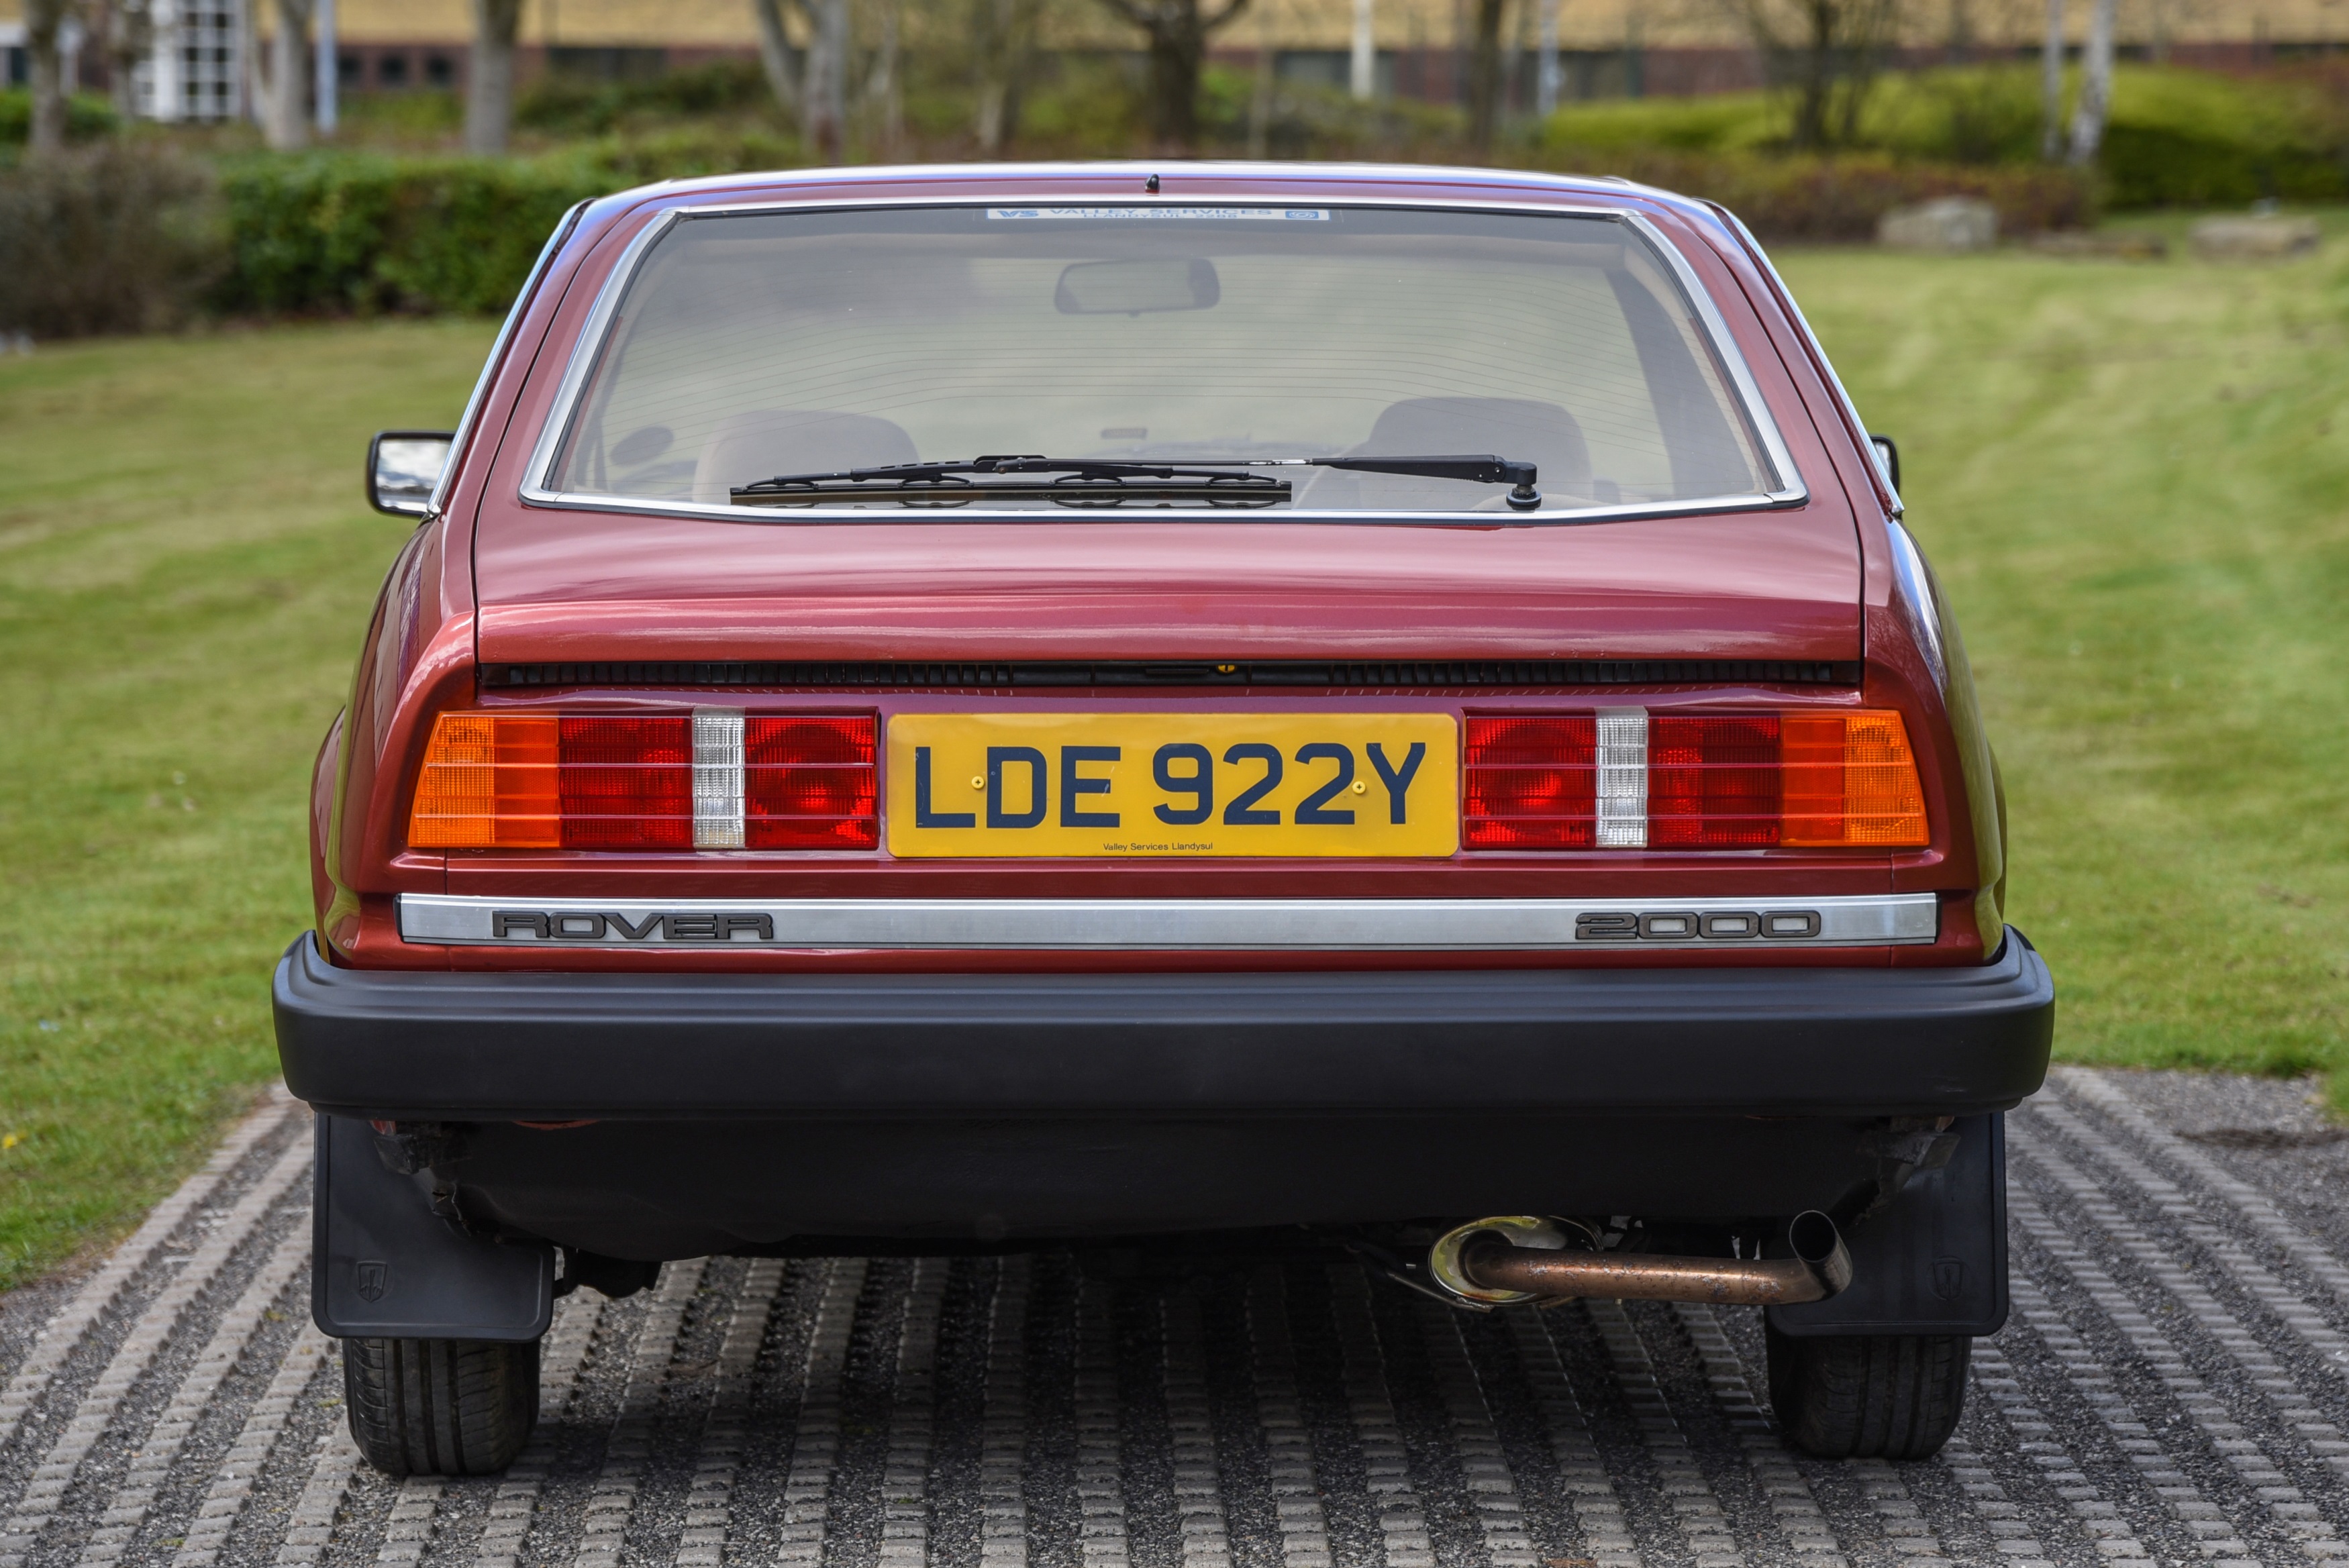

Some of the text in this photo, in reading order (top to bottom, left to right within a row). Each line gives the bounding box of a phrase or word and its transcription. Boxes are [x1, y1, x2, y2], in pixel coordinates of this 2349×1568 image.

[997, 209, 1039, 217] VS
[915, 742, 1426, 829] LDE 922Y
[1103, 842, 1213, 852] Valley Services Llandysul
[492, 910, 773, 939] ROVER
[1575, 910, 1821, 940] 2000
